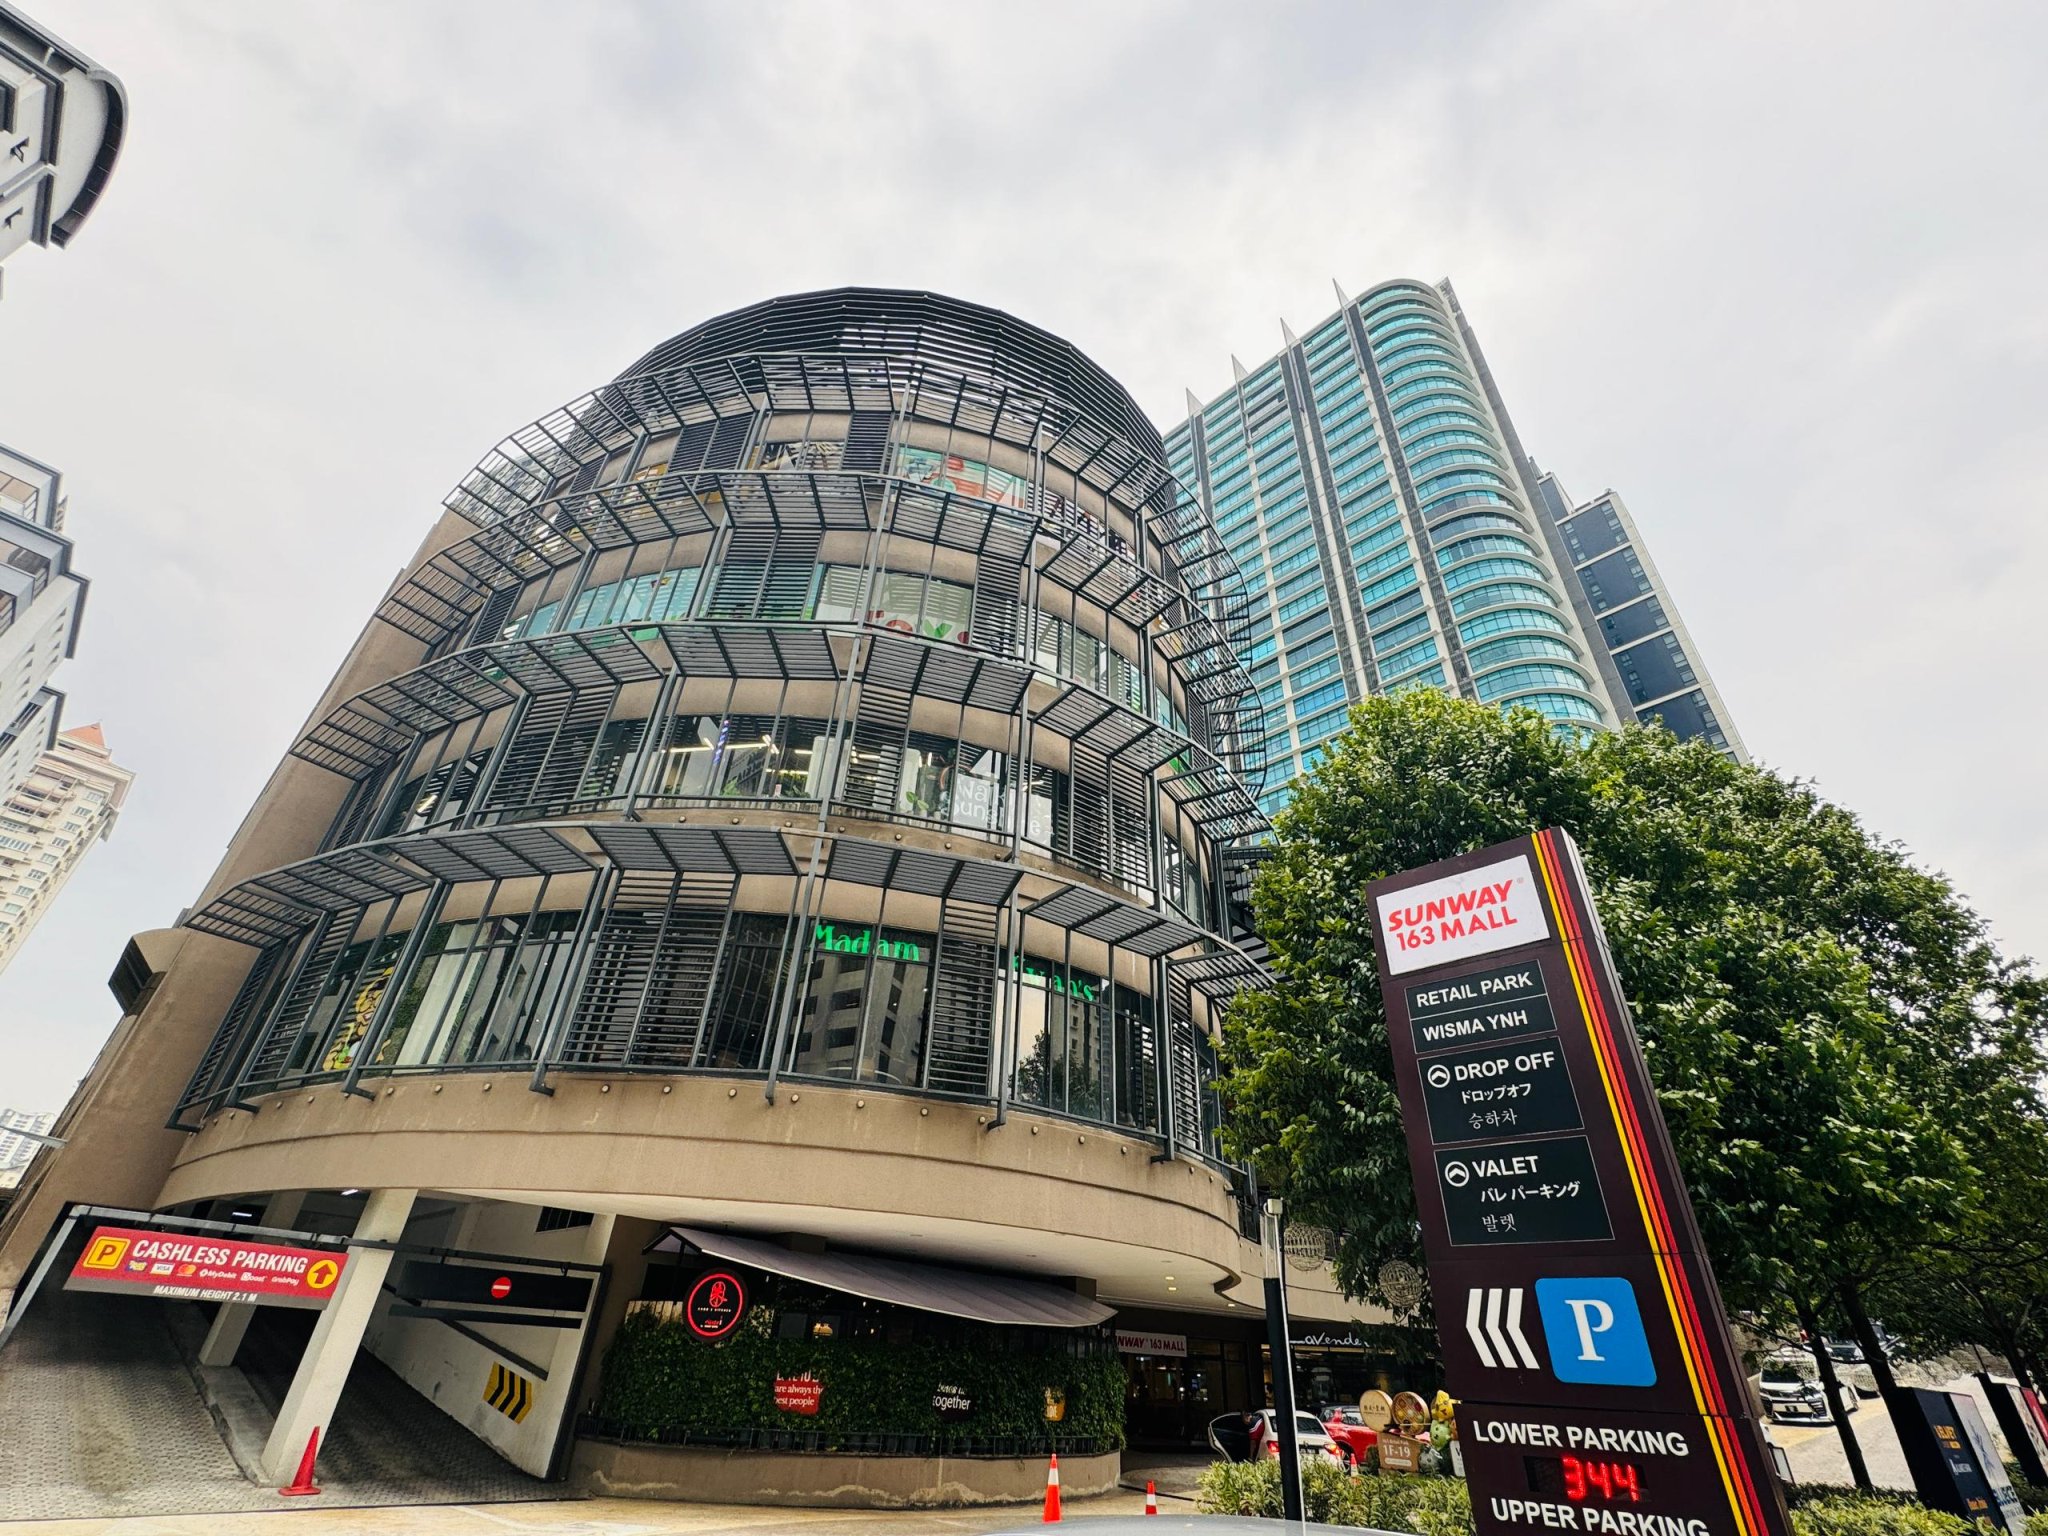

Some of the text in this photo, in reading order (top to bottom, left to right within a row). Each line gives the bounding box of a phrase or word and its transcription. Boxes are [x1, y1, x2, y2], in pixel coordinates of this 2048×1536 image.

[1388, 879, 1513, 932] SUNWAY
[814, 924, 920, 961] Madam
[1396, 906, 1517, 950] 163 MALL
[1416, 972, 1533, 1007] RETAIL PARK
[1423, 1010, 1528, 1042] WISMA YNH
[1454, 1051, 1555, 1081] DROP OFF
[1461, 1083, 1532, 1104] ドロップオフ
[1468, 1108, 1518, 1130] 승하차
[1472, 1155, 1539, 1178] VALET
[1481, 1213, 1517, 1233] 발렛
[132, 1239, 230, 1267] CASHLESS
[231, 1252, 308, 1274] PARKING
[153, 1285, 258, 1302] MAXIMUM HEIGHT 2.1 M
[1164, 1340, 1185, 1351] MALL
[1564, 1298, 1614, 1362] P
[788, 1384, 811, 1396] always
[789, 1396, 815, 1407] people
[1473, 1420, 1689, 1457] LOWER PARKING
[1562, 1455, 1641, 1503] 344
[1491, 1497, 1711, 1536] UPPER PARKING
